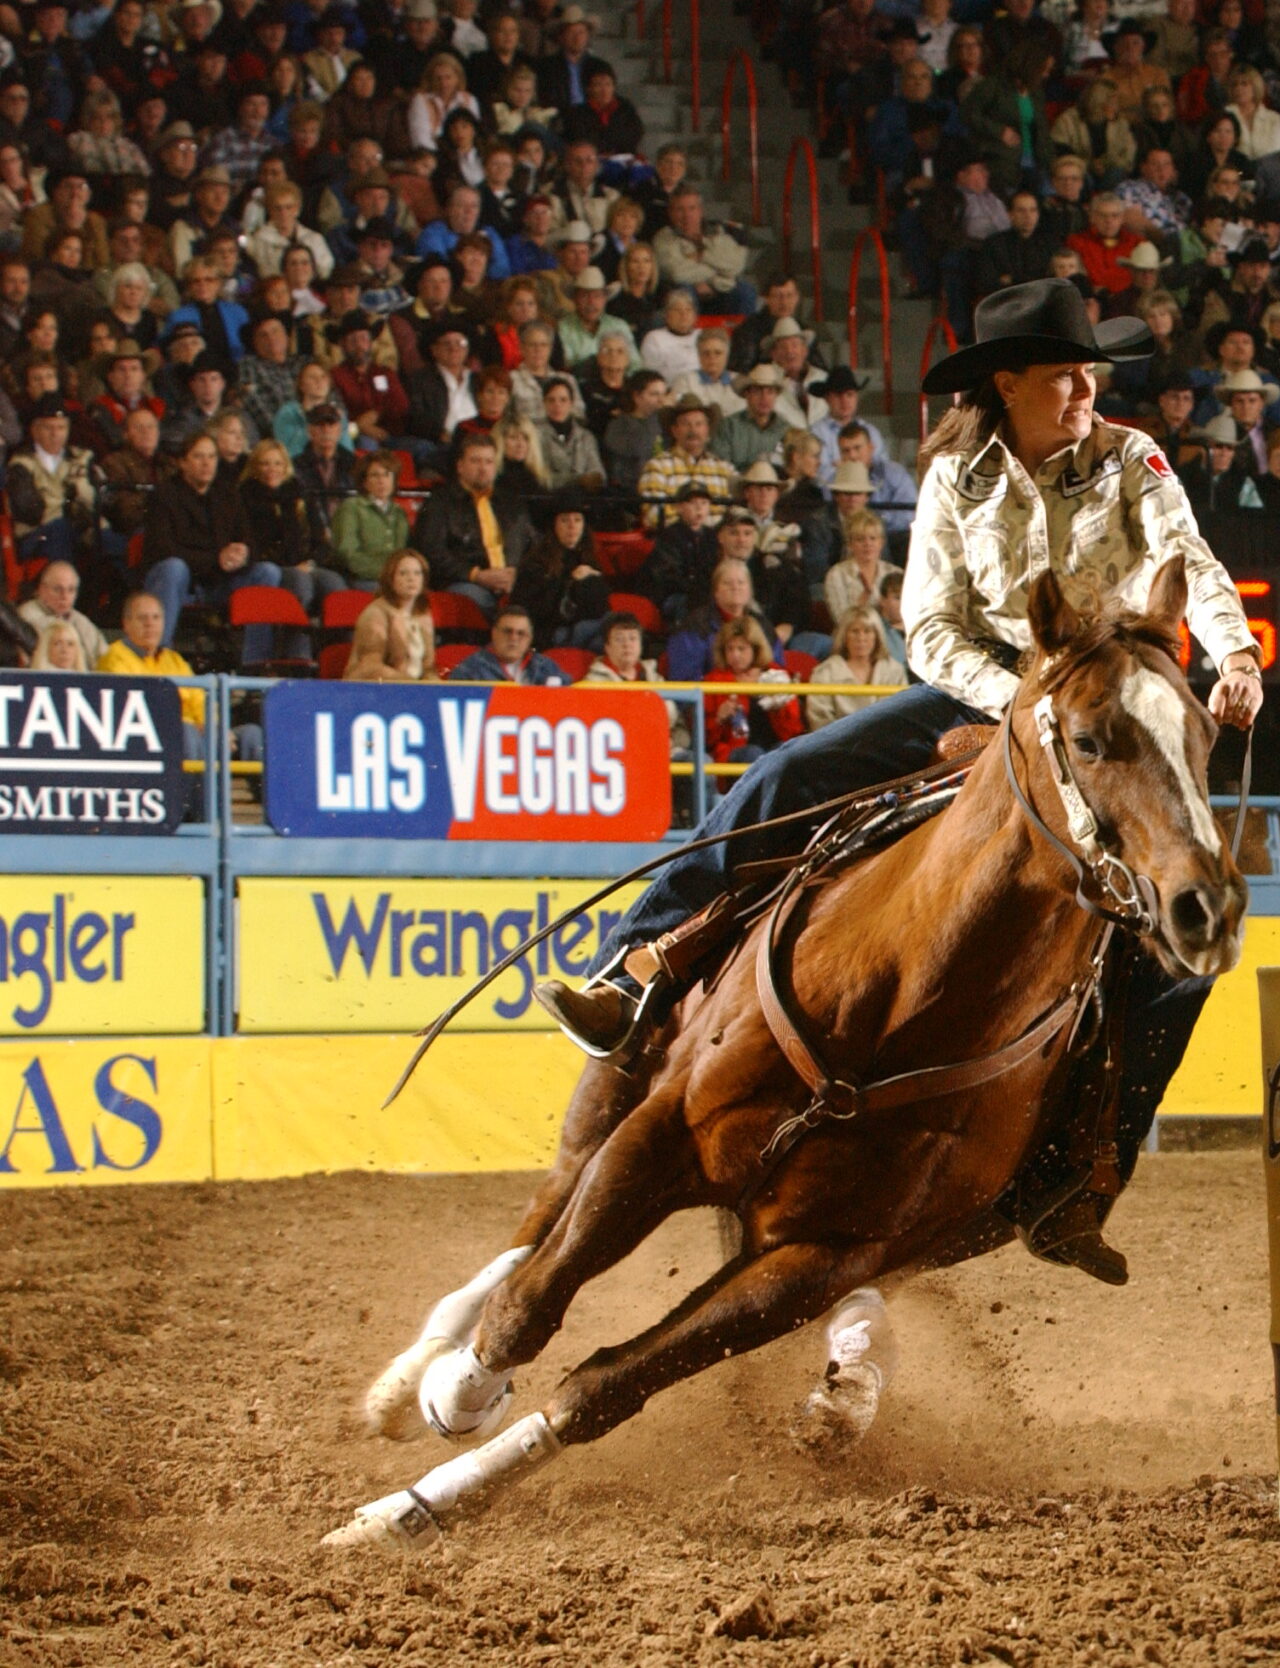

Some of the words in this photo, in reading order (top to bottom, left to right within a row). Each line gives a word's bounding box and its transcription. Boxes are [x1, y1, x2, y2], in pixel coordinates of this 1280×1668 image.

[314, 712, 425, 812] LAS
[439, 699, 626, 821] VEGAS
[0, 893, 136, 1028] gler
[0, 1055, 163, 1174] AS
